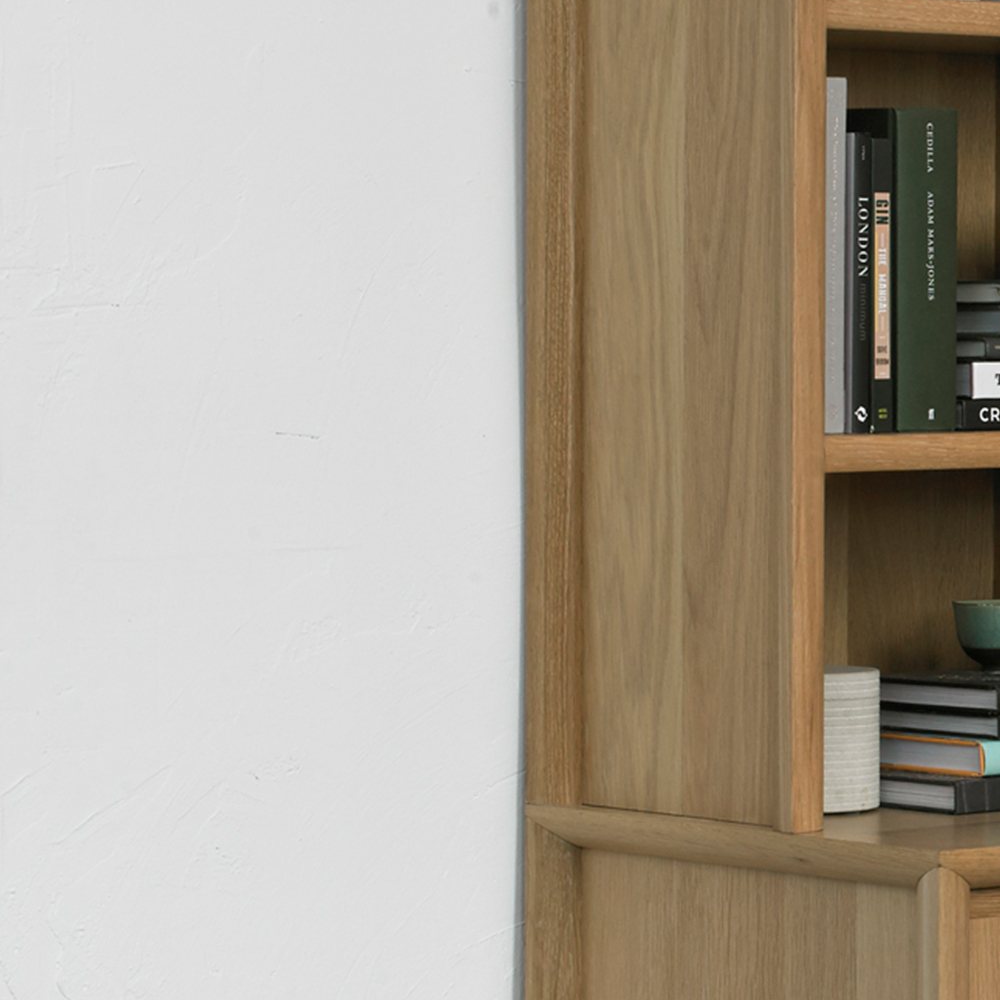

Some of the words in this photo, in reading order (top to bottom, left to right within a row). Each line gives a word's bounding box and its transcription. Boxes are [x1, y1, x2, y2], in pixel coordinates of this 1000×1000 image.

[926, 122, 934, 173] CEDILLA
[876, 200, 889, 225] GIN
[926, 191, 934, 225] ADAM
[857, 197, 869, 277] LONDON
[878, 247, 887, 266] THE
[925, 228, 935, 302] MARS-JONES
[859, 283, 868, 341] minimum
